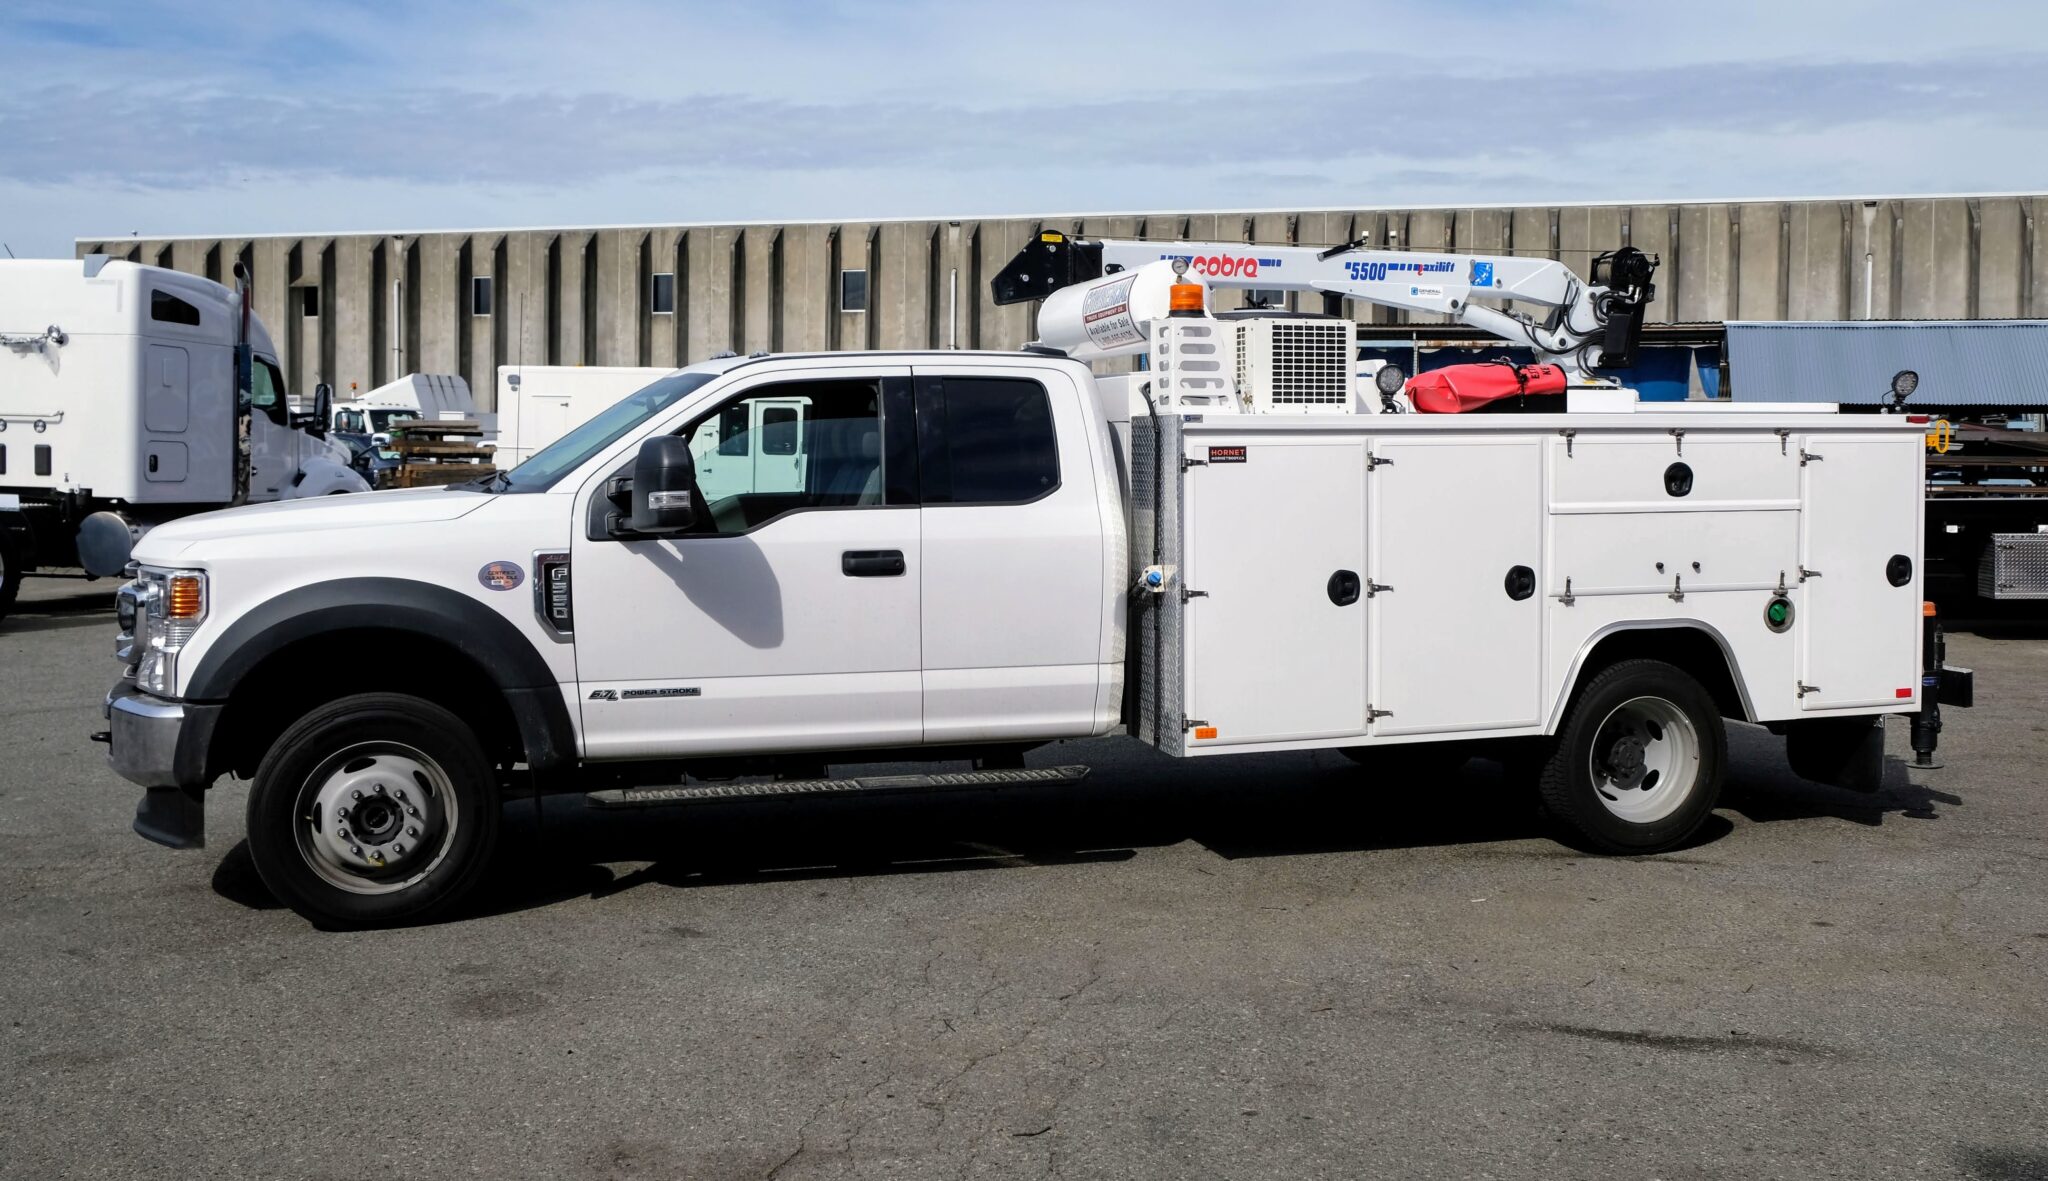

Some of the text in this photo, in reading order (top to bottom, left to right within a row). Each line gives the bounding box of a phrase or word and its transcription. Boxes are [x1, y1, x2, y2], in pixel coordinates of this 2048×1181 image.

[1193, 253, 1257, 278] cobra
[1350, 262, 1387, 280] 5500
[1089, 322, 1111, 336] Available
[1110, 319, 1119, 330] for
[1118, 316, 1130, 328] Sale
[623, 689, 658, 697] POWER
[659, 687, 699, 695] STROKE
